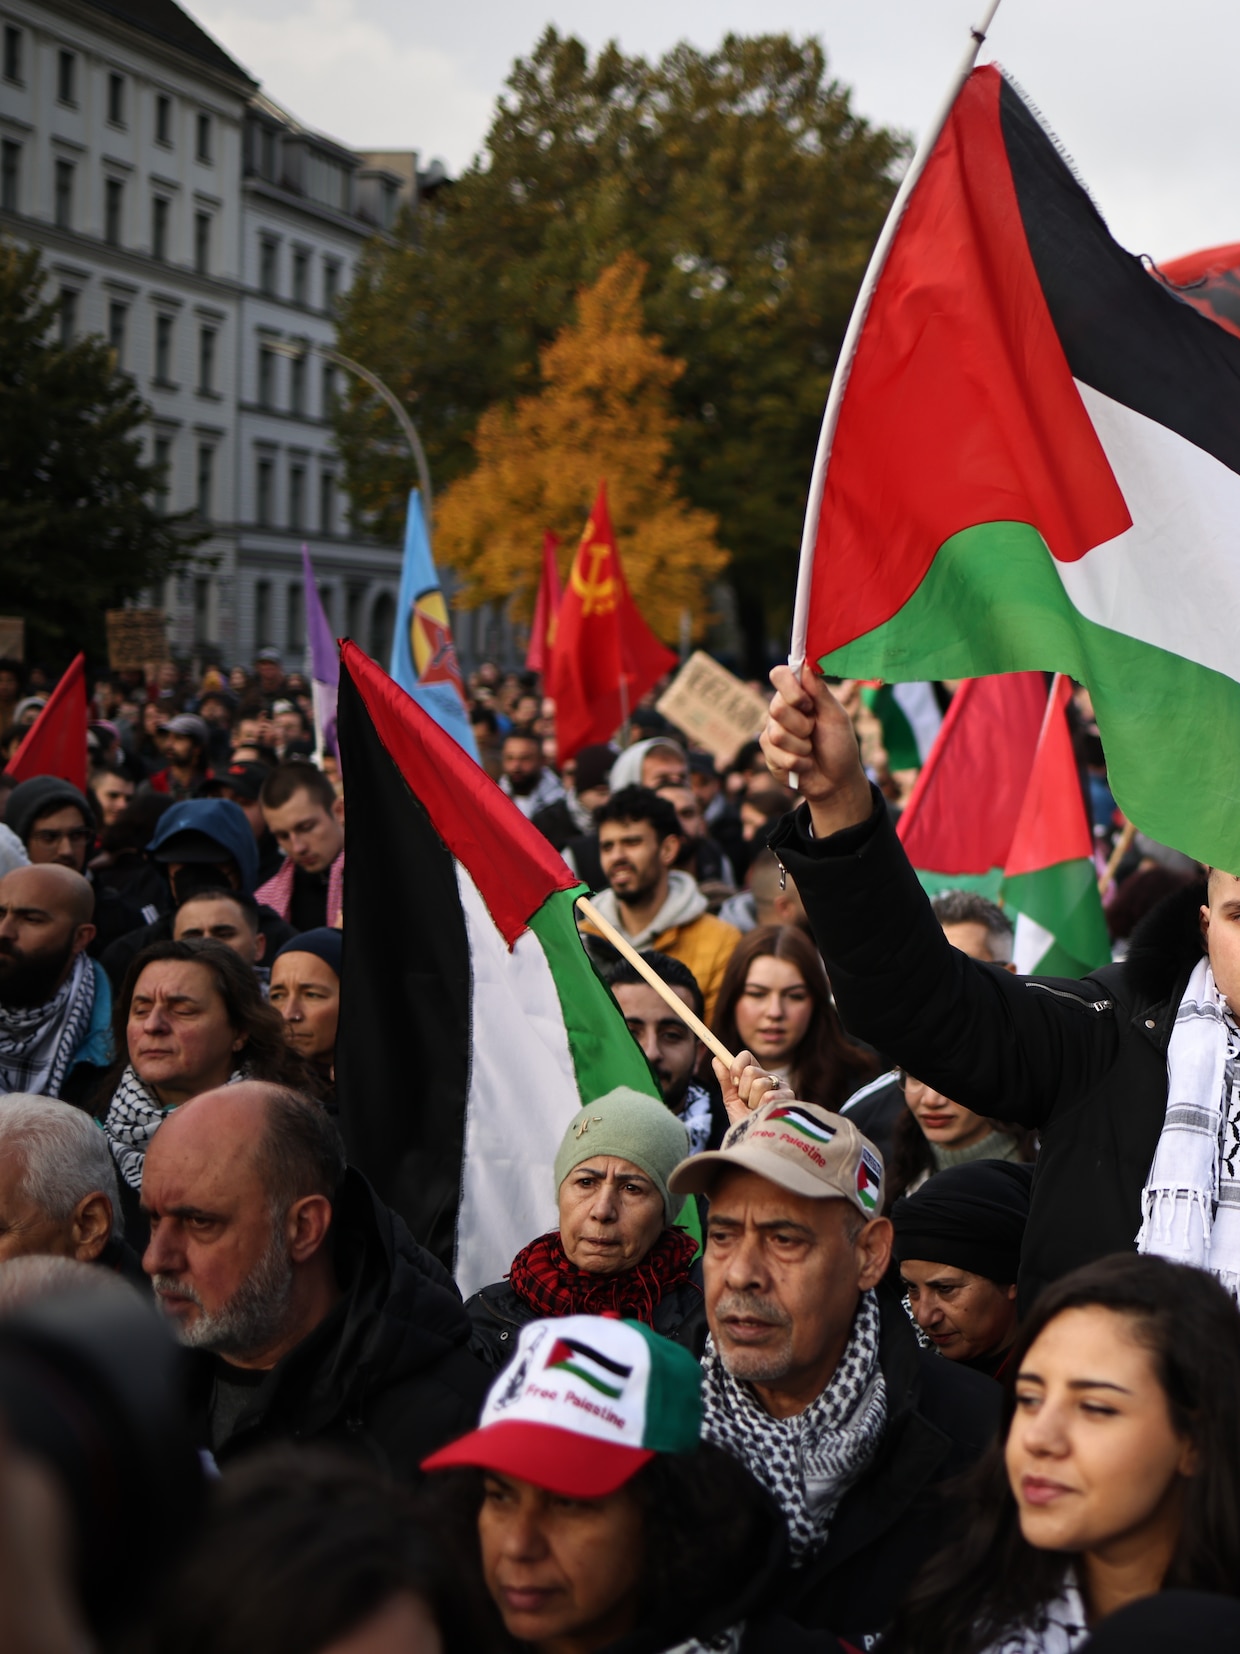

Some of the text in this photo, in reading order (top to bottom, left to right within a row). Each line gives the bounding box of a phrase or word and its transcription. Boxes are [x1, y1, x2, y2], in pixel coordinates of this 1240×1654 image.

[778, 1132, 827, 1168] Palestine
[525, 1383, 627, 1430] Free Palestine
